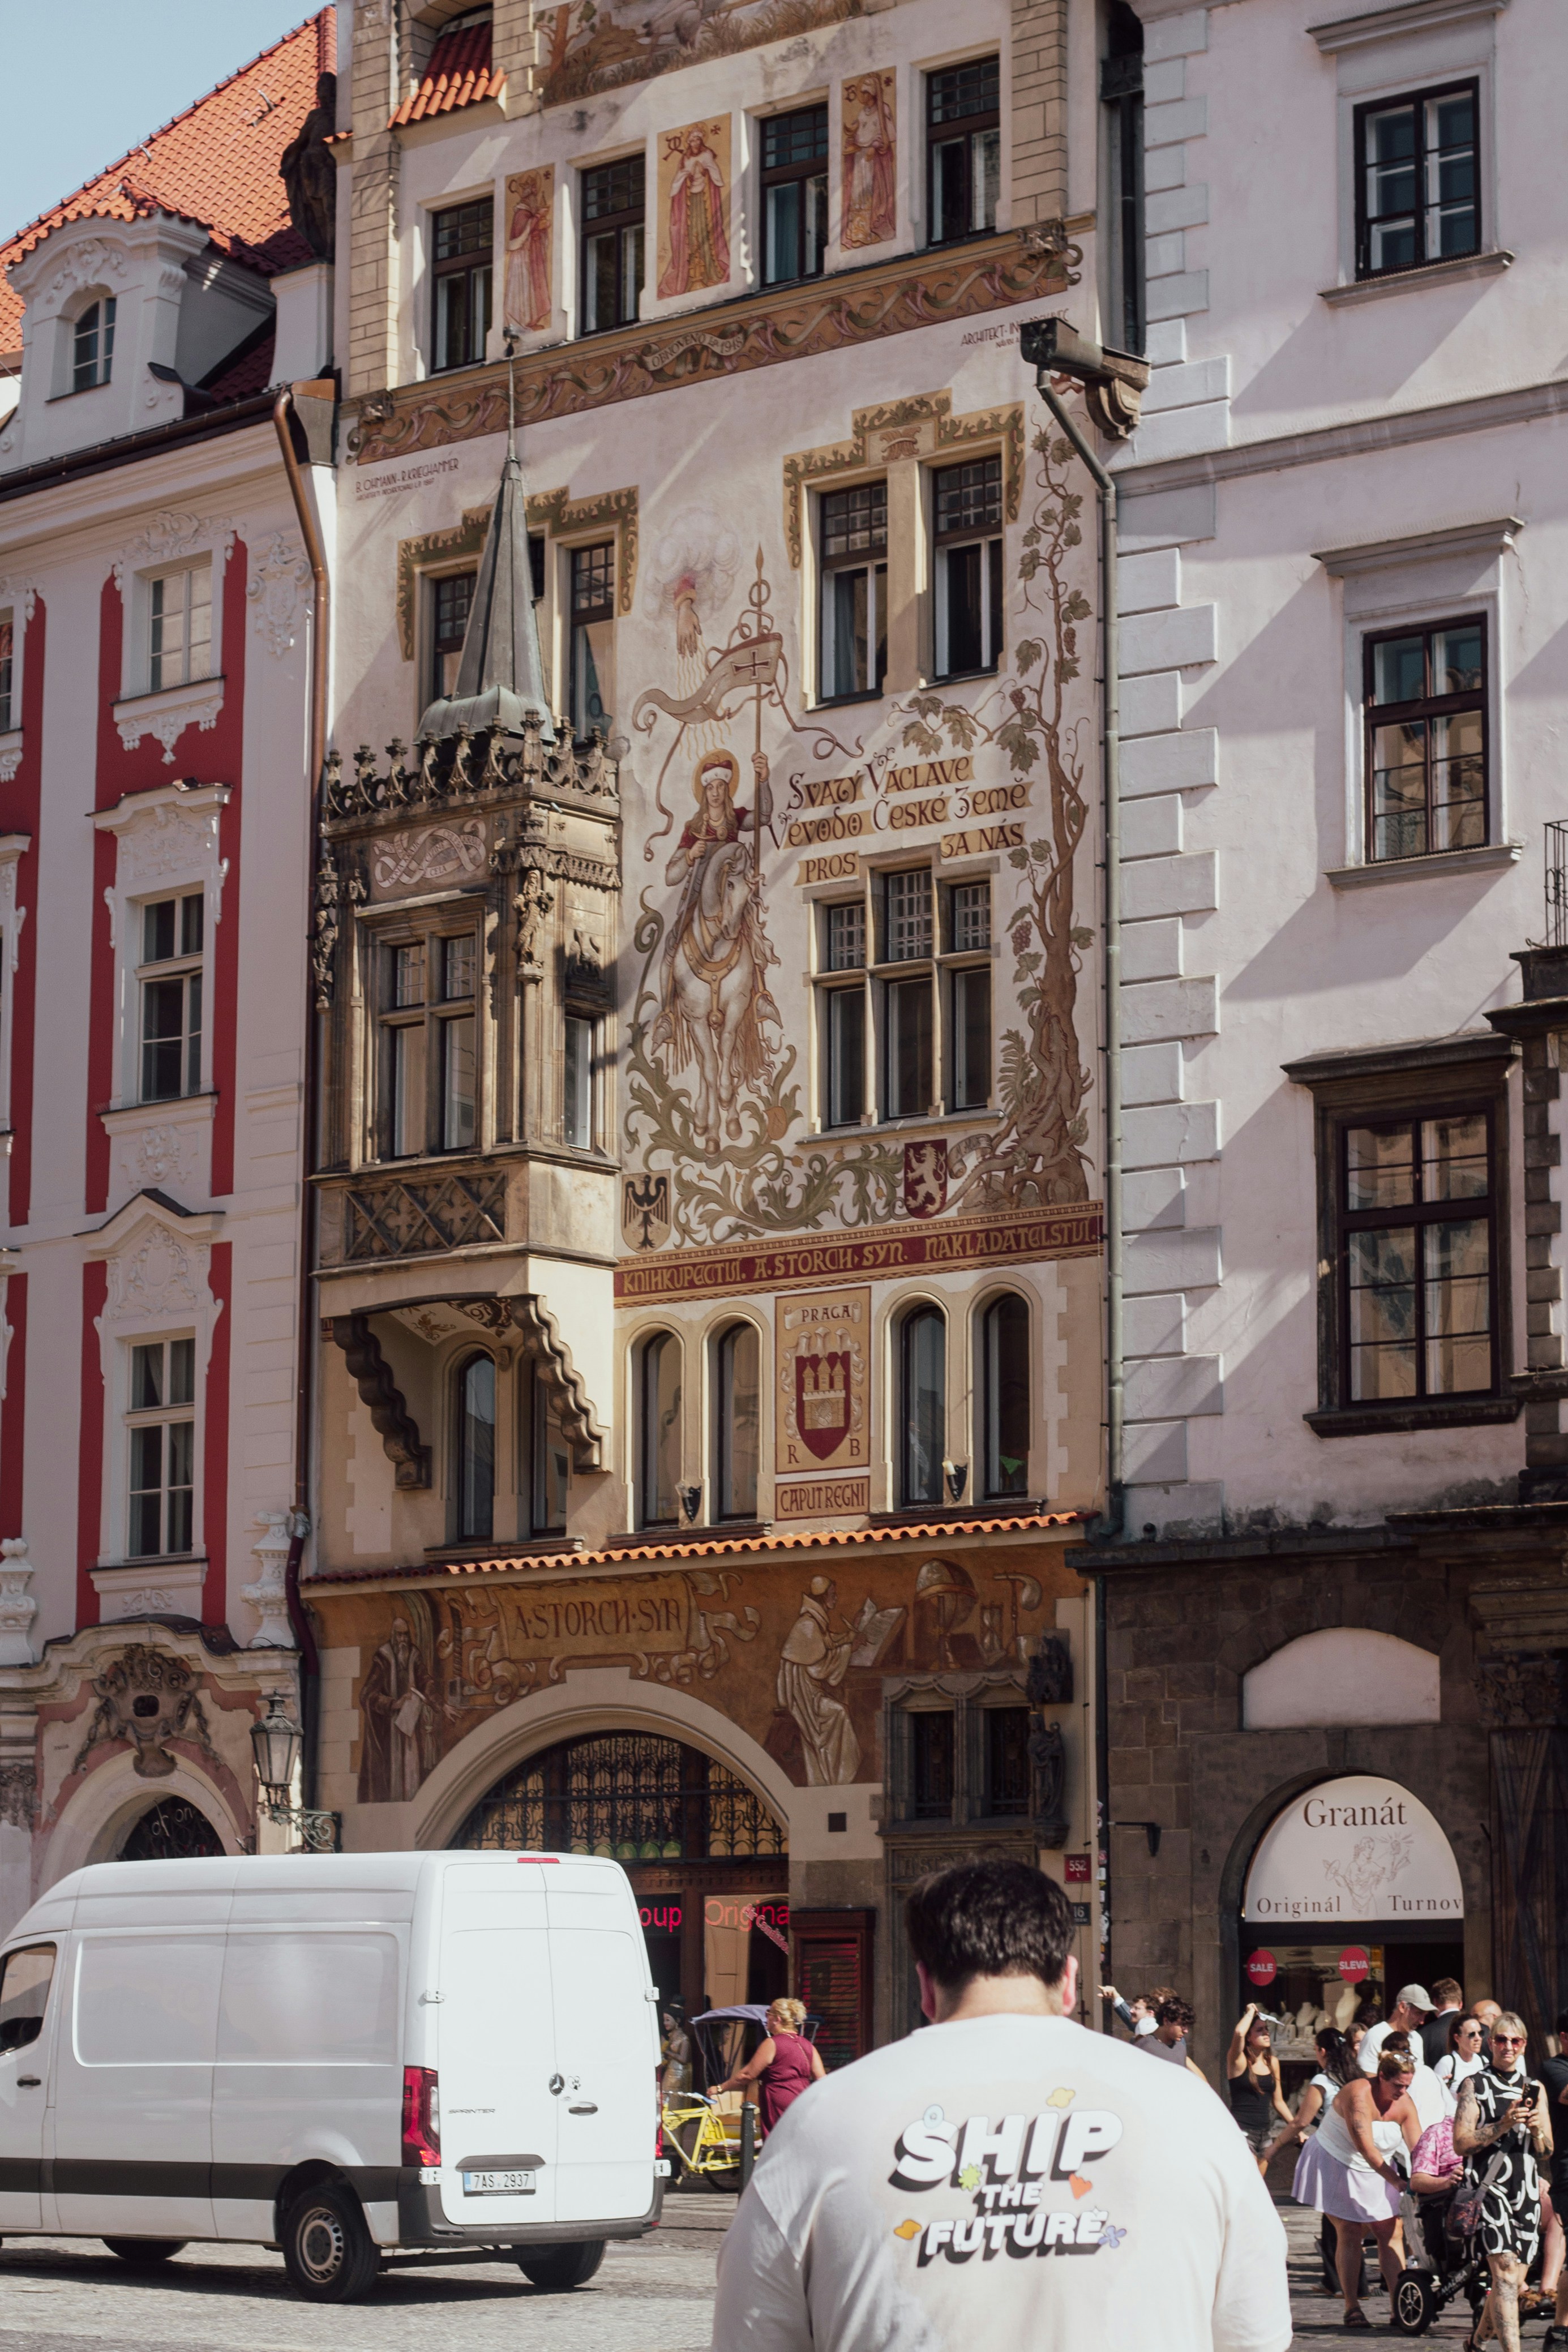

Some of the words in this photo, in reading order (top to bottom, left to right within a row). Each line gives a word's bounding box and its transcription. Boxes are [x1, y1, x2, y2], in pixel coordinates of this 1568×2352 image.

[652, 332, 706, 367] OBNOVENO
[804, 852, 858, 883] PROS
[976, 820, 1024, 852] NÁS
[802, 1304, 851, 1323] PRAGA
[787, 1444, 800, 1464] R
[850, 1438, 860, 1456] B
[1303, 1797, 1407, 1828] Granát
[1069, 1860, 1086, 1872] 552
[1257, 1896, 1341, 1918] Originál
[1387, 1895, 1463, 1912] Turnov
[1249, 1963, 1274, 1973] SALE
[1338, 1961, 1369, 1970] SLEVA
[888, 2110, 1124, 2192] SHIP
[474, 2174, 494, 2188] 7AS
[503, 2173, 529, 2187] 2937
[972, 2182, 1045, 2214] THE
[916, 2209, 1109, 2268] FUTURE
